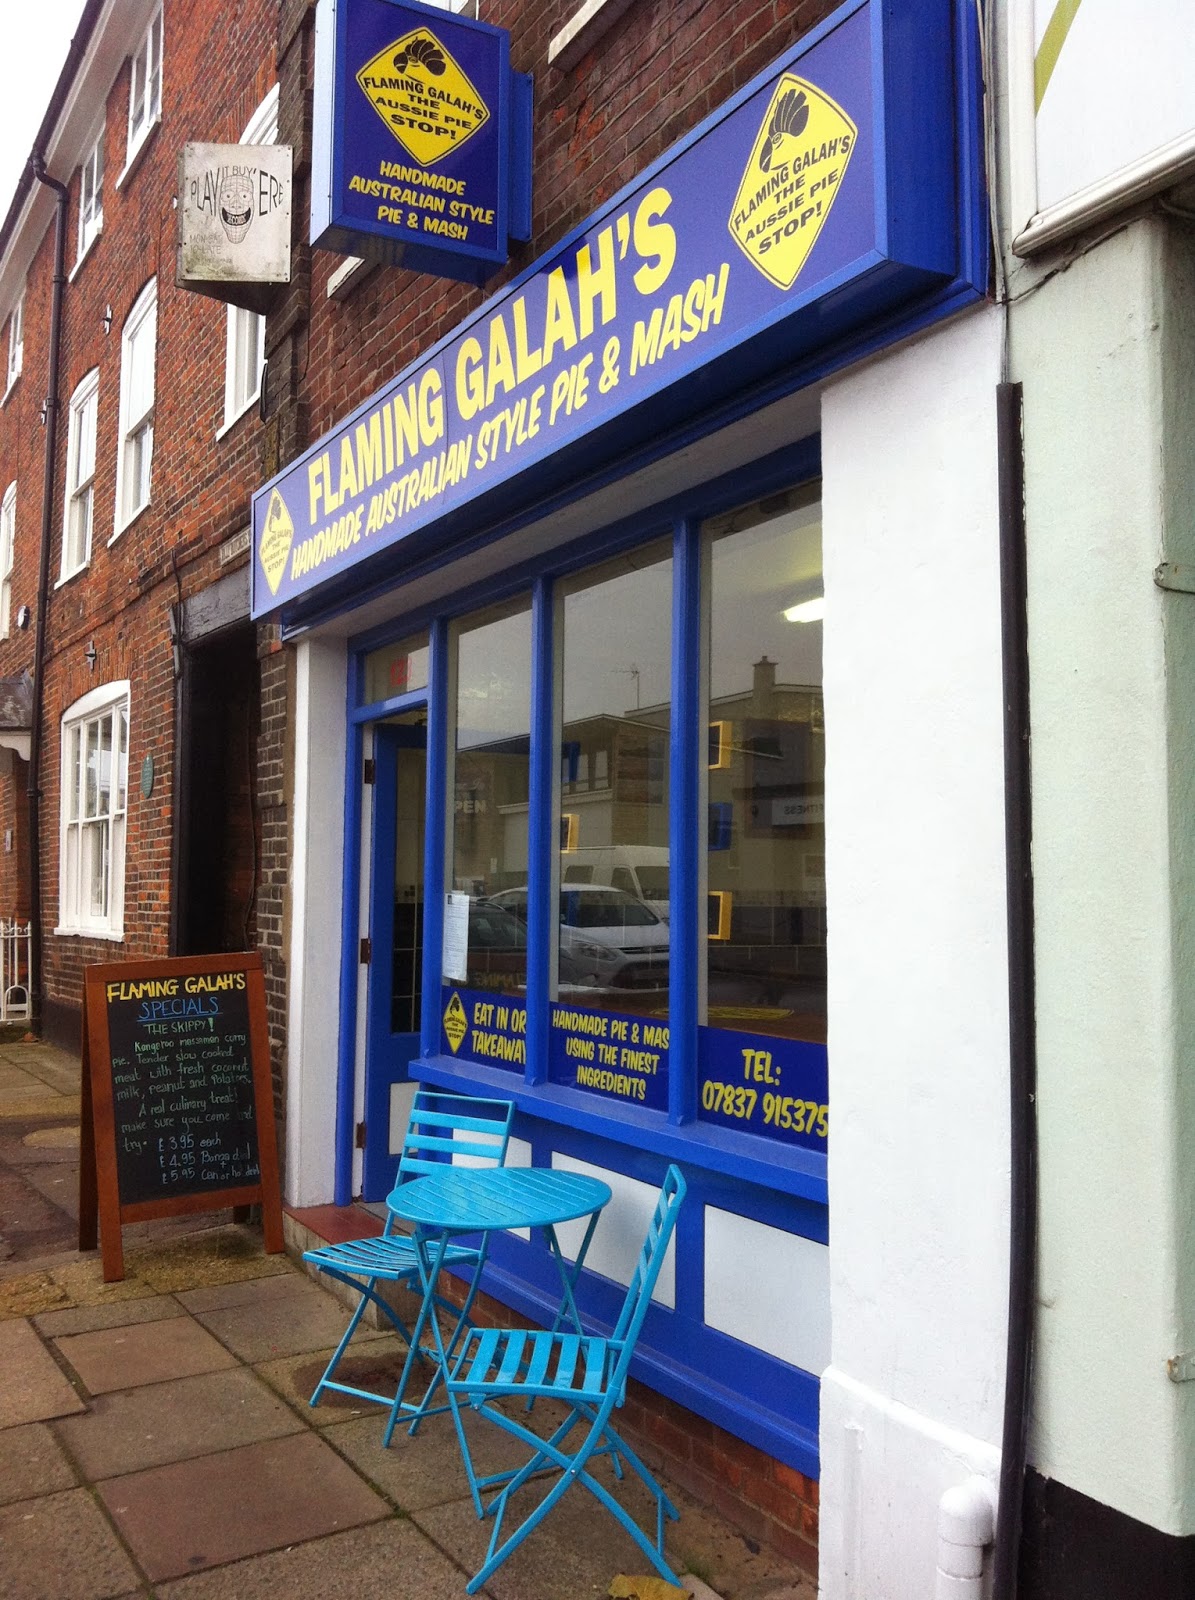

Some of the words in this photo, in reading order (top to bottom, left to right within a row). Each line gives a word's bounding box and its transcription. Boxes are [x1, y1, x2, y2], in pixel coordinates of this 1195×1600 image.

[363, 77, 424, 94] FLAMING
[428, 86, 484, 120] GALAH'S
[375, 96, 439, 121] AUSSIE
[444, 115, 472, 130] PIE
[408, 93, 440, 110] THE
[390, 114, 456, 140] STOP!
[380, 160, 466, 196] HANDMADE
[734, 167, 789, 232] FLAMING
[793, 135, 850, 175] GALAH'S
[773, 174, 806, 205] THE
[349, 175, 445, 214] AUSTRALIAN
[449, 201, 495, 225] STYLE
[745, 193, 804, 243] AUSSIE
[809, 168, 838, 198] PIE
[378, 205, 403, 225] PIE
[407, 213, 419, 229] &
[424, 218, 468, 241] MASH
[758, 201, 822, 255] STOP!
[308, 368, 444, 525] FLAMING
[455, 187, 677, 420] GALAH'S
[291, 504, 364, 580] HANDMADE
[365, 434, 473, 537] AUSTRALIAN
[475, 384, 545, 470] STYLE
[549, 352, 593, 426] PIE
[599, 336, 620, 393] &
[629, 263, 730, 376] MASH
[107, 979, 180, 1003] FLAMING
[184, 973, 246, 994] GALAH'S
[138, 996, 219, 1020] SPECIALS
[142, 1022, 168, 1035] THE
[171, 1017, 214, 1034] SKIPPY!
[473, 1002, 495, 1028] EAT
[496, 1006, 509, 1031] IN
[511, 1008, 527, 1034] OR
[552, 1009, 608, 1037] HANDMADE
[610, 1019, 629, 1041] PIE
[631, 1022, 640, 1044] &
[643, 1024, 670, 1050] MAS
[114, 1068, 142, 1084] meat
[149, 1064, 172, 1079] with
[176, 1061, 205, 1075] fresh
[175, 1050, 197, 1062] slow
[566, 1037, 595, 1061] USING
[598, 1043, 619, 1066] THE
[620, 1048, 660, 1076] FINEST
[741, 1048, 781, 1086] TEL:
[576, 1064, 647, 1101] INGREDIENTS
[121, 1120, 148, 1134] make
[154, 1117, 175, 1129] sure
[181, 1114, 203, 1134] you
[205, 1111, 230, 1122] come
[138, 1102, 147, 1118] A
[169, 1095, 207, 1112] culinary
[702, 1080, 758, 1121] 07837
[762, 1092, 829, 1138] 915375
[199, 1131, 222, 1148] each
